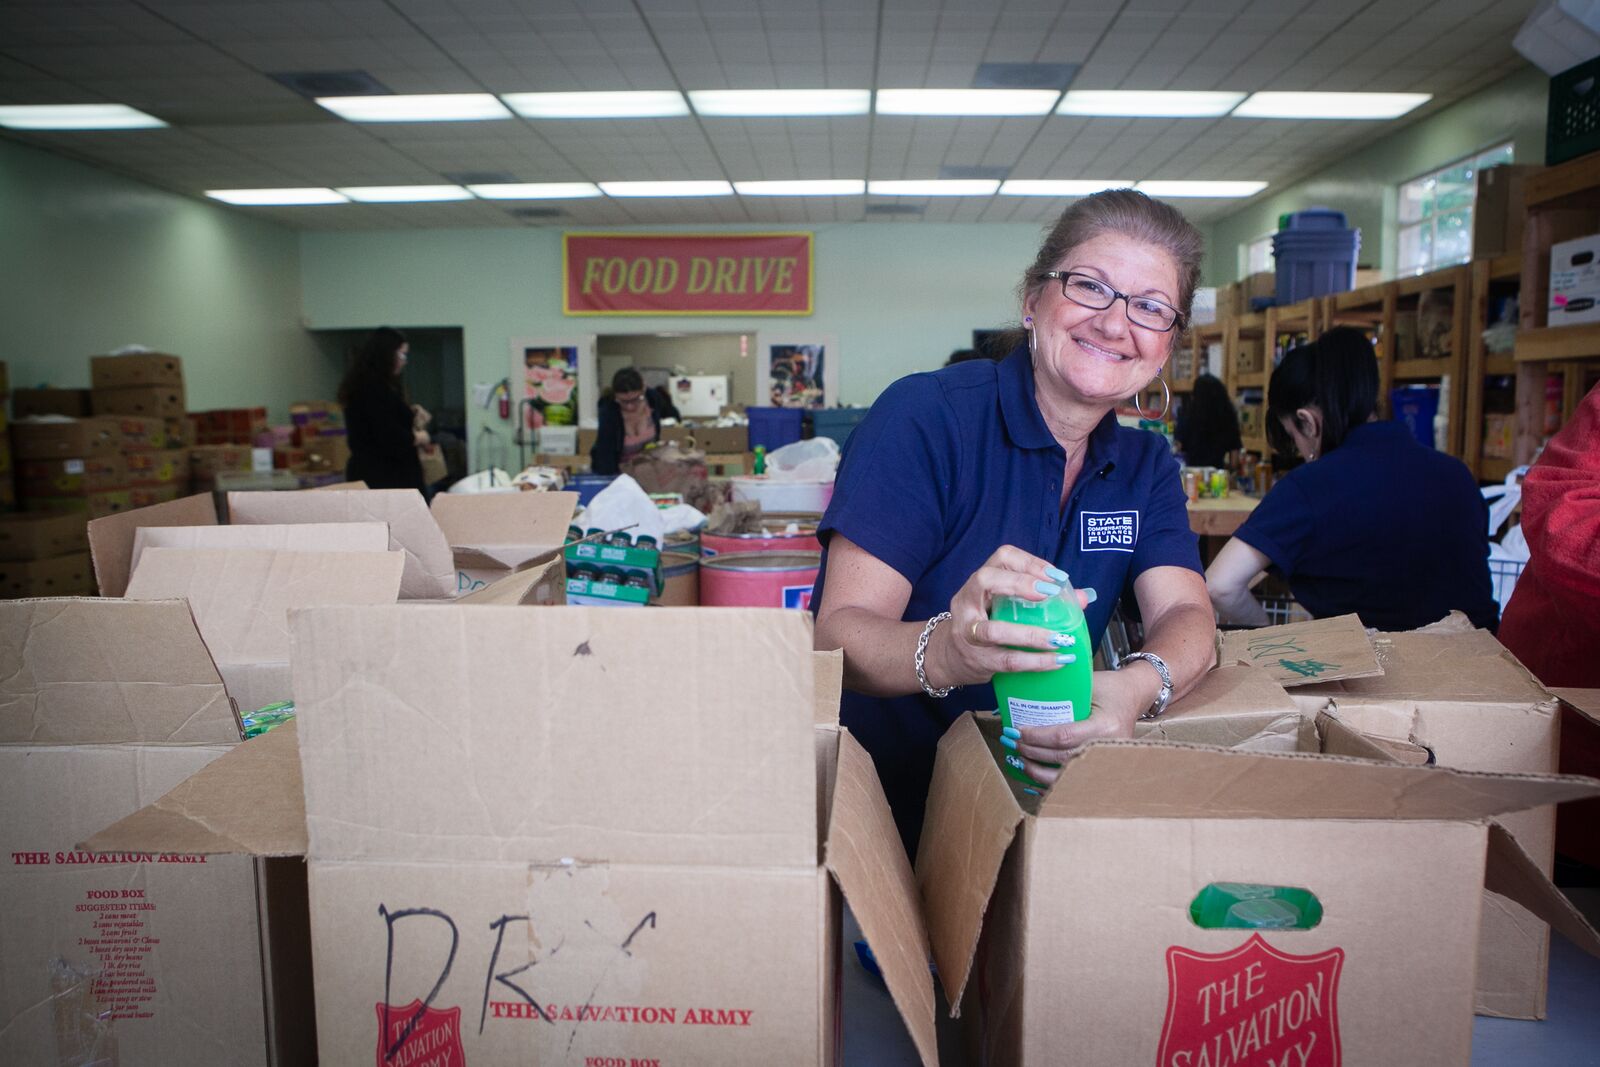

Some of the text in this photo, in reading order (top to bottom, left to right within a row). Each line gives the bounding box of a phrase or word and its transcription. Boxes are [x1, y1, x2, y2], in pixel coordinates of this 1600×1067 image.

[581, 256, 798, 295] FOOD DRIVE
[1087, 516, 1132, 526] STATE
[1088, 534, 1133, 545] FUND
[12, 852, 50, 864] THE
[55, 851, 153, 864] SALVATION
[86, 889, 144, 899] FOOD BOX
[75, 903, 126, 912] SUGGESTED
[120, 929, 137, 937] fruit
[1197, 960, 1267, 1026] THE
[490, 1001, 754, 1026] THE SALVATION ARMY
[386, 1017, 453, 1067] ALVATION
[585, 1057, 626, 1067] FOOD
